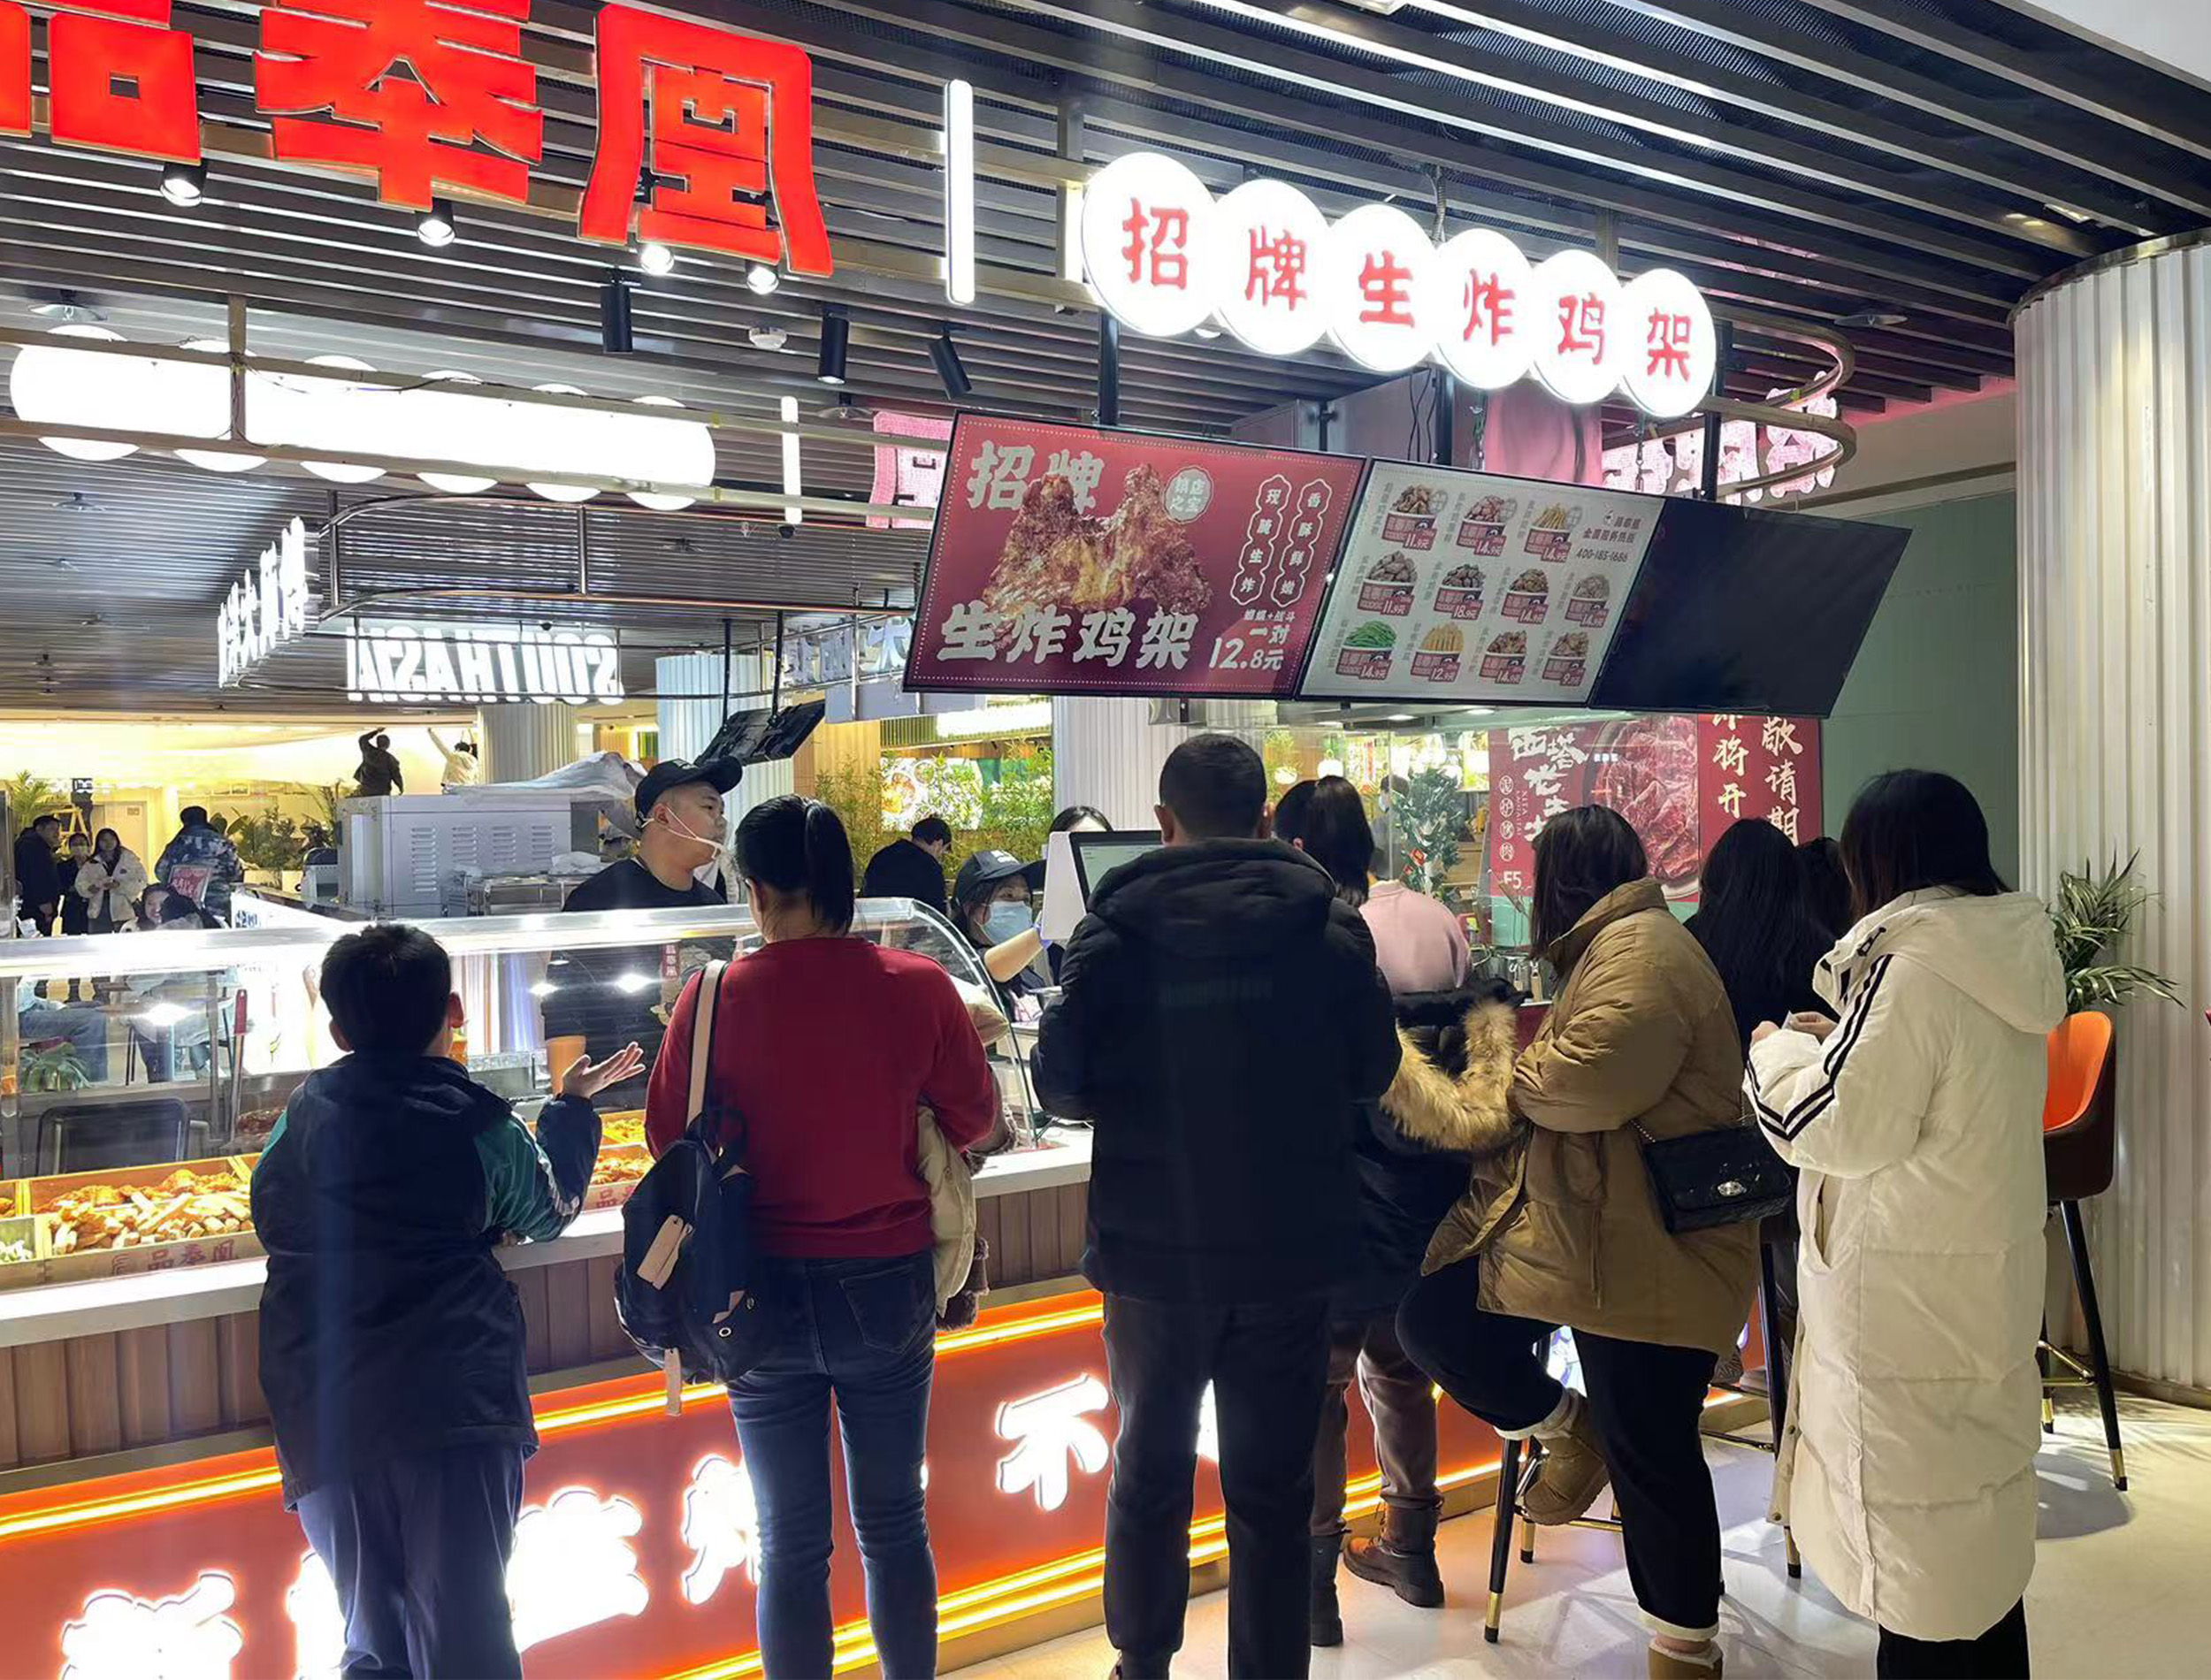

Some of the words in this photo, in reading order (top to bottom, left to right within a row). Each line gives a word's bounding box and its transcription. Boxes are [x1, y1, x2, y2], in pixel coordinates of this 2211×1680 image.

[1121, 197, 1691, 383] 招牌生炸鸡架
[968, 440, 1105, 513] 招牌
[937, 599, 1197, 670] 生炸鸡架
[1209, 637, 1284, 670] 12.8元
[1250, 624, 1290, 645] 一对
[1762, 716, 1803, 847] 敬请期
